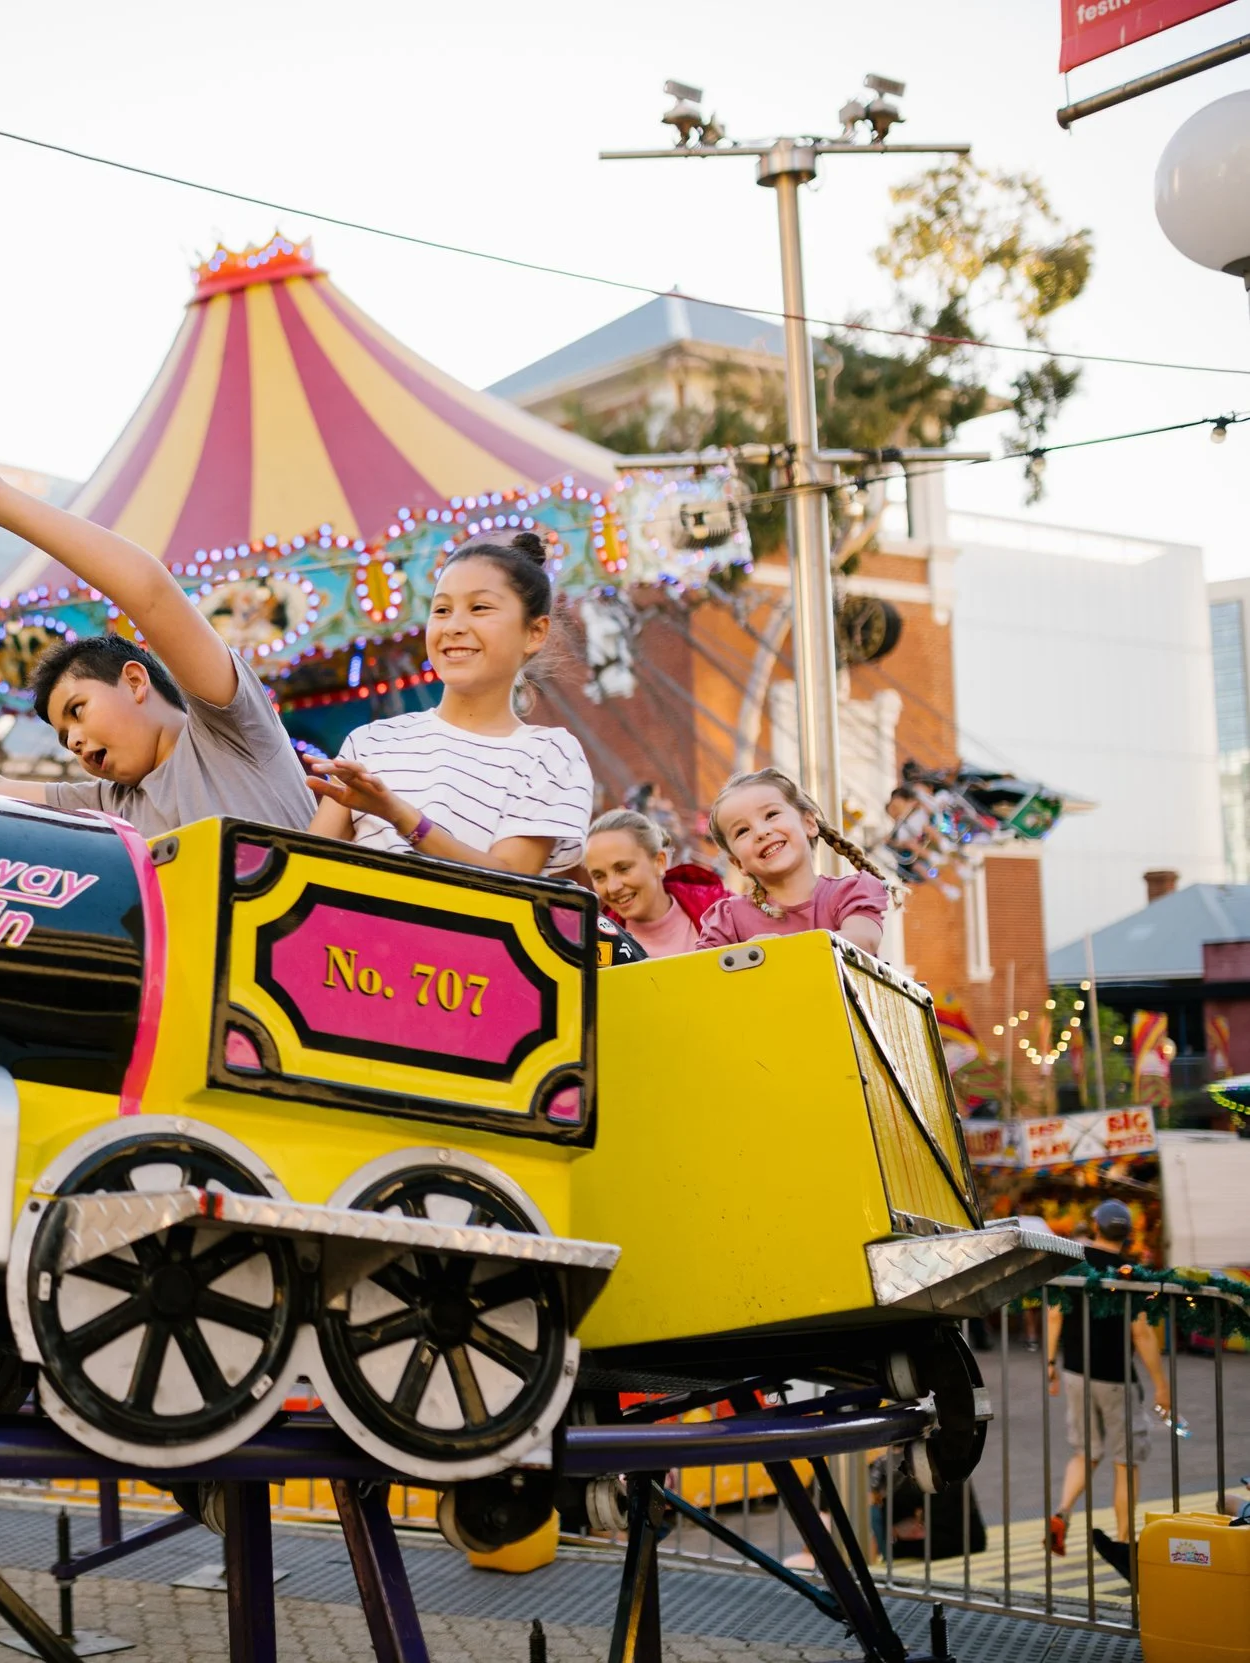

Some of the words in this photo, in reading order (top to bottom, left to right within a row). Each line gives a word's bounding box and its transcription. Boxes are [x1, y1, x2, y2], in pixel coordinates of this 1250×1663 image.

[323, 944, 395, 999] No.
[411, 963, 490, 1017] 707
[1107, 1109, 1149, 1132] BIG
